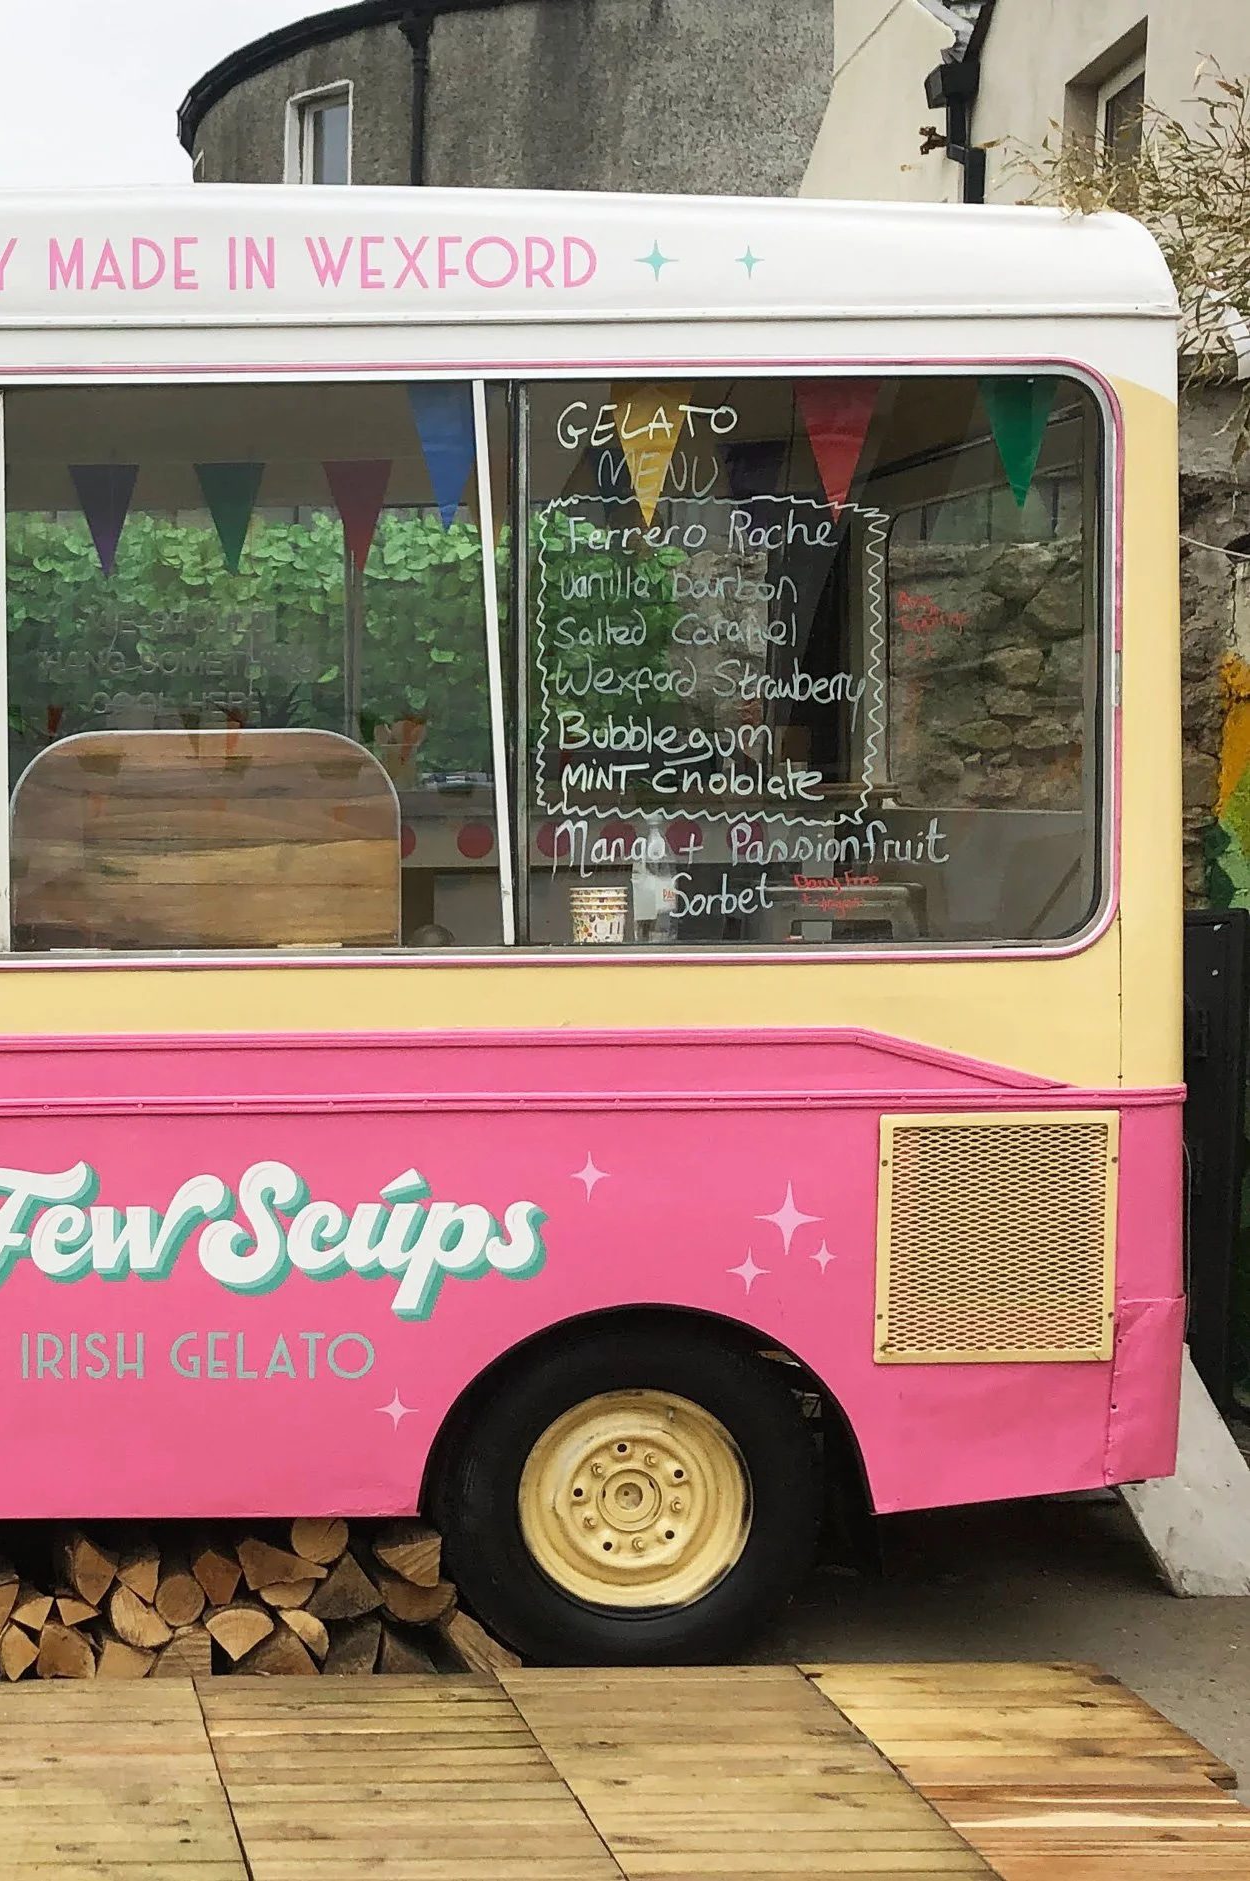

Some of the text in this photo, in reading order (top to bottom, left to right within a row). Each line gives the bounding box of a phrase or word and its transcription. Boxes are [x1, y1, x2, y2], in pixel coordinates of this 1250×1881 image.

[48, 237, 199, 291] MADE
[229, 237, 276, 291] IN
[304, 236, 598, 291] WEXFORD
[557, 401, 738, 449] GELATO
[597, 450, 718, 498] MENU
[568, 515, 707, 553] Ferrero
[553, 607, 647, 649] Salted
[555, 655, 868, 733] Wexford Strawberry
[558, 710, 774, 768] Bubblegum
[552, 818, 668, 881] Mango
[668, 871, 776, 919] Sorbet
[196, 1159, 550, 1322] Scúps
[21, 1331, 145, 1380] IRISH
[170, 1330, 376, 1381] GELATO
